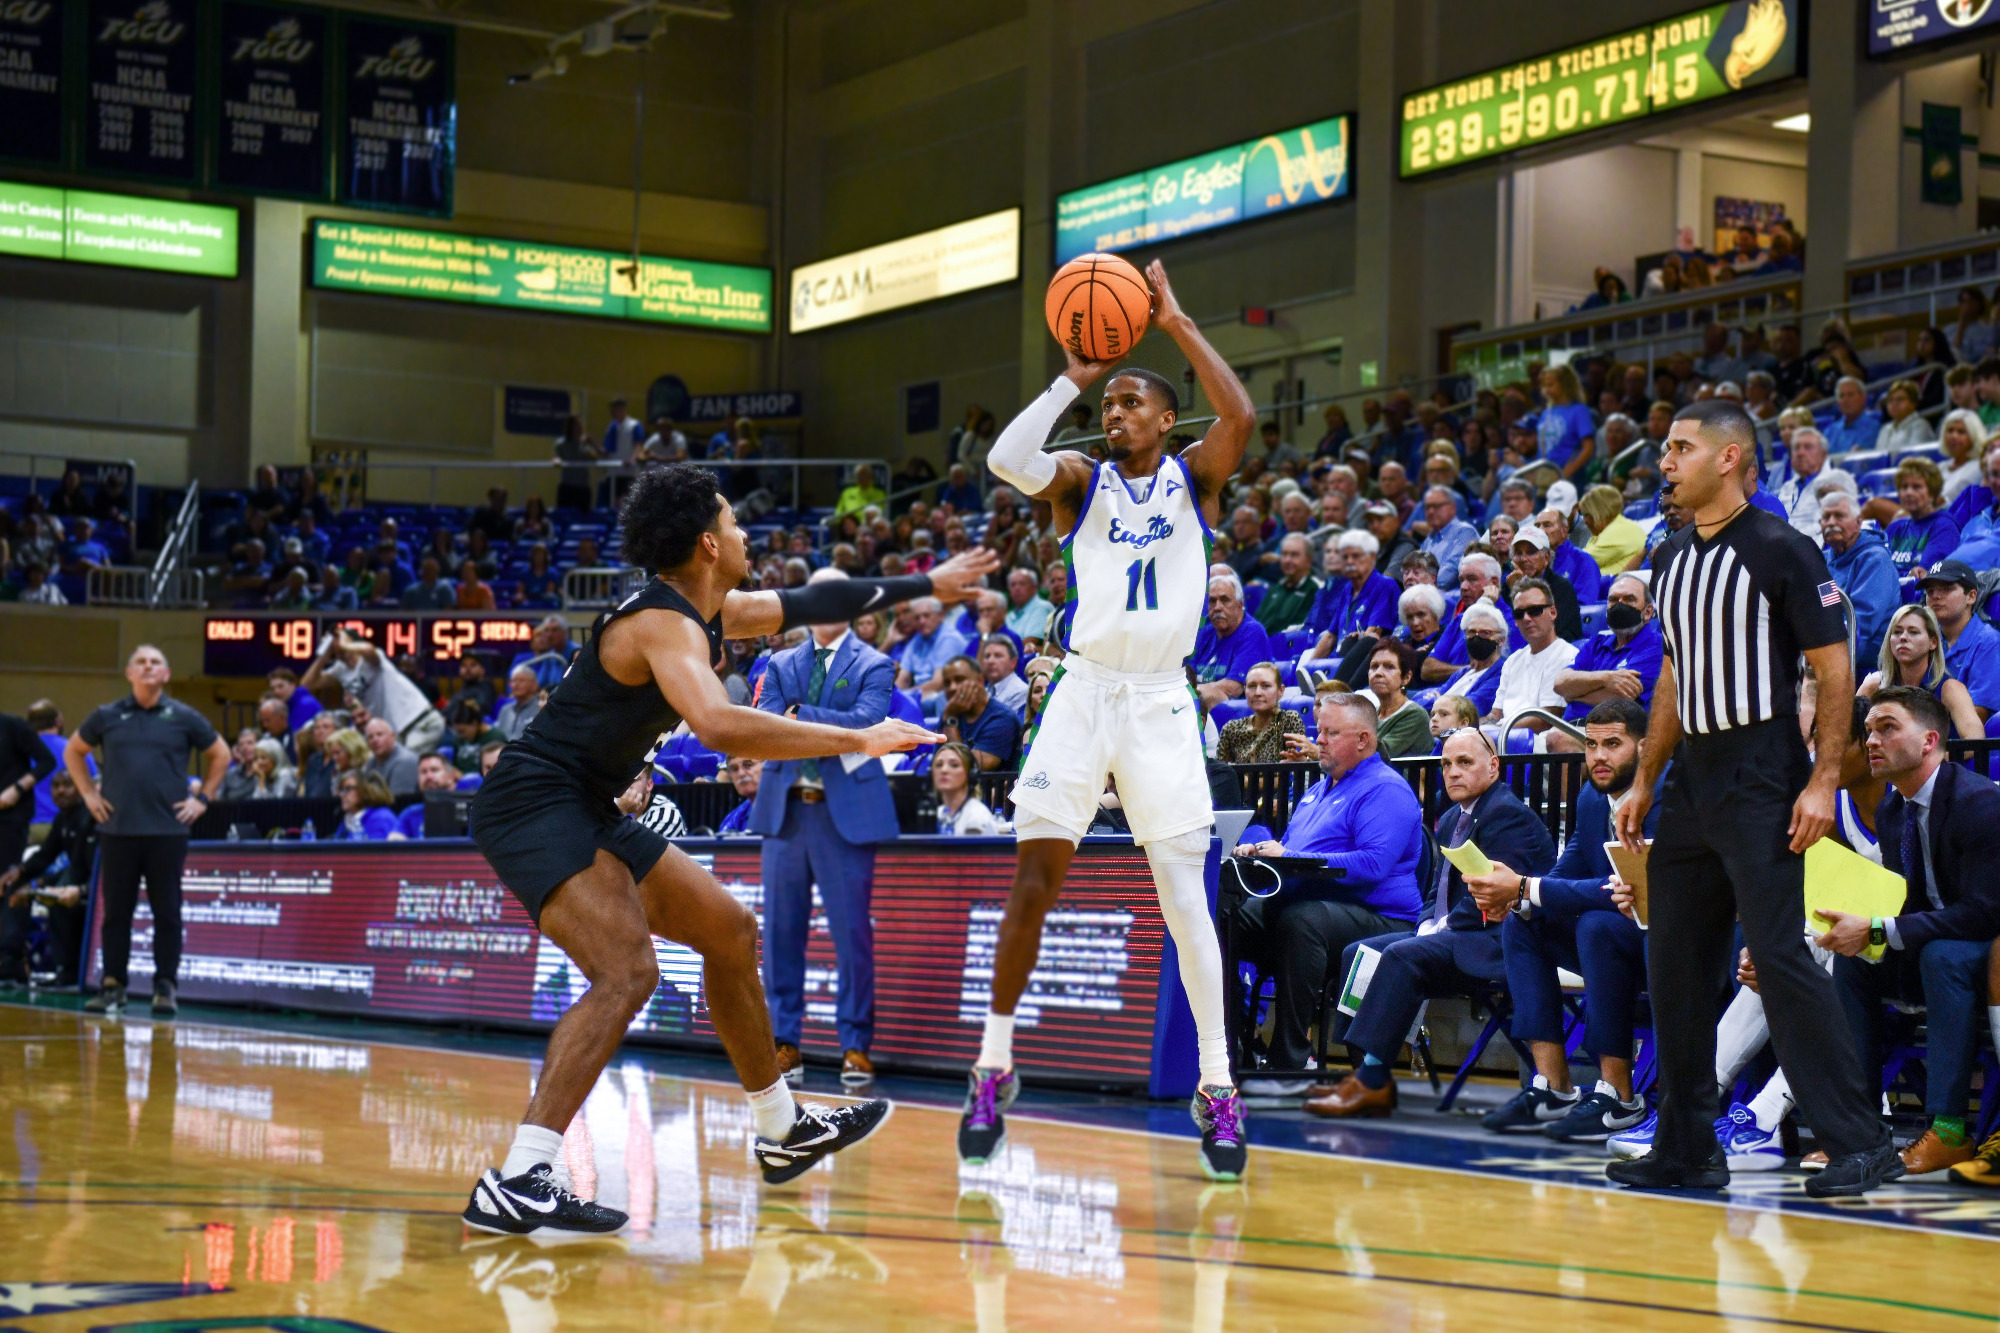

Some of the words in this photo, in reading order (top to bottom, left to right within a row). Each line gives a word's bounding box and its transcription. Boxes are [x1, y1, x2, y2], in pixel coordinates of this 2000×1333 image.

[0, 1, 51, 23] CU
[99, 18, 184, 43] FGCU
[231, 38, 314, 62] FGCU
[116, 65, 167, 91] NCAA
[356, 56, 436, 80] FGCU
[1405, 93, 1439, 120] GET
[1445, 76, 1494, 109] YOUR
[1501, 60, 1551, 94] FGCU
[1558, 33, 1647, 78] TICKETS
[1653, 14, 1710, 50] NOW!
[92, 82, 192, 112] TOURNAMENT
[248, 83, 296, 108] NCAA
[225, 101, 319, 129] TOURNAMENT
[372, 101, 419, 124] NCAA
[1411, 52, 1698, 169] 239.590.7145
[1152, 175, 1177, 206] Go
[1181, 152, 1246, 205] Eagles!
[19, 200, 63, 220] Catering
[74, 207, 106, 222] Events
[109, 214, 129, 227] and
[130, 214, 177, 234] Wedding
[179, 219, 222, 239] Planning
[26, 225, 63, 241] Events
[74, 230, 135, 249] Exceptional
[137, 238, 202, 257] Celebrations
[318, 224, 339, 239] Get
[351, 228, 393, 246] Special
[395, 234, 426, 249] FGCU
[428, 237, 452, 253] Rate
[455, 240, 486, 257] When
[488, 244, 509, 260] You
[334, 244, 367, 262] Make
[379, 250, 445, 271] Reservation
[446, 258, 473, 274] With
[515, 248, 606, 272] HOMEWOOD
[645, 263, 692, 283] Hilton
[326, 266, 357, 282] Proud
[409, 277, 420, 288] of
[422, 276, 449, 292] FGCU
[559, 267, 606, 286] SUITES
[812, 266, 874, 309] CAM
[642, 299, 665, 311] Fort
[643, 278, 720, 307] Garden
[723, 285, 763, 310] Inn
[691, 398, 732, 418] FAN
[736, 393, 794, 416] SHOP
[1109, 514, 1175, 549] Eagles
[1126, 557, 1158, 611] 11
[207, 620, 253, 640] EAGLES
[270, 620, 312, 659] 48
[432, 620, 476, 660] 52
[1023, 776, 1050, 789] FGCU
